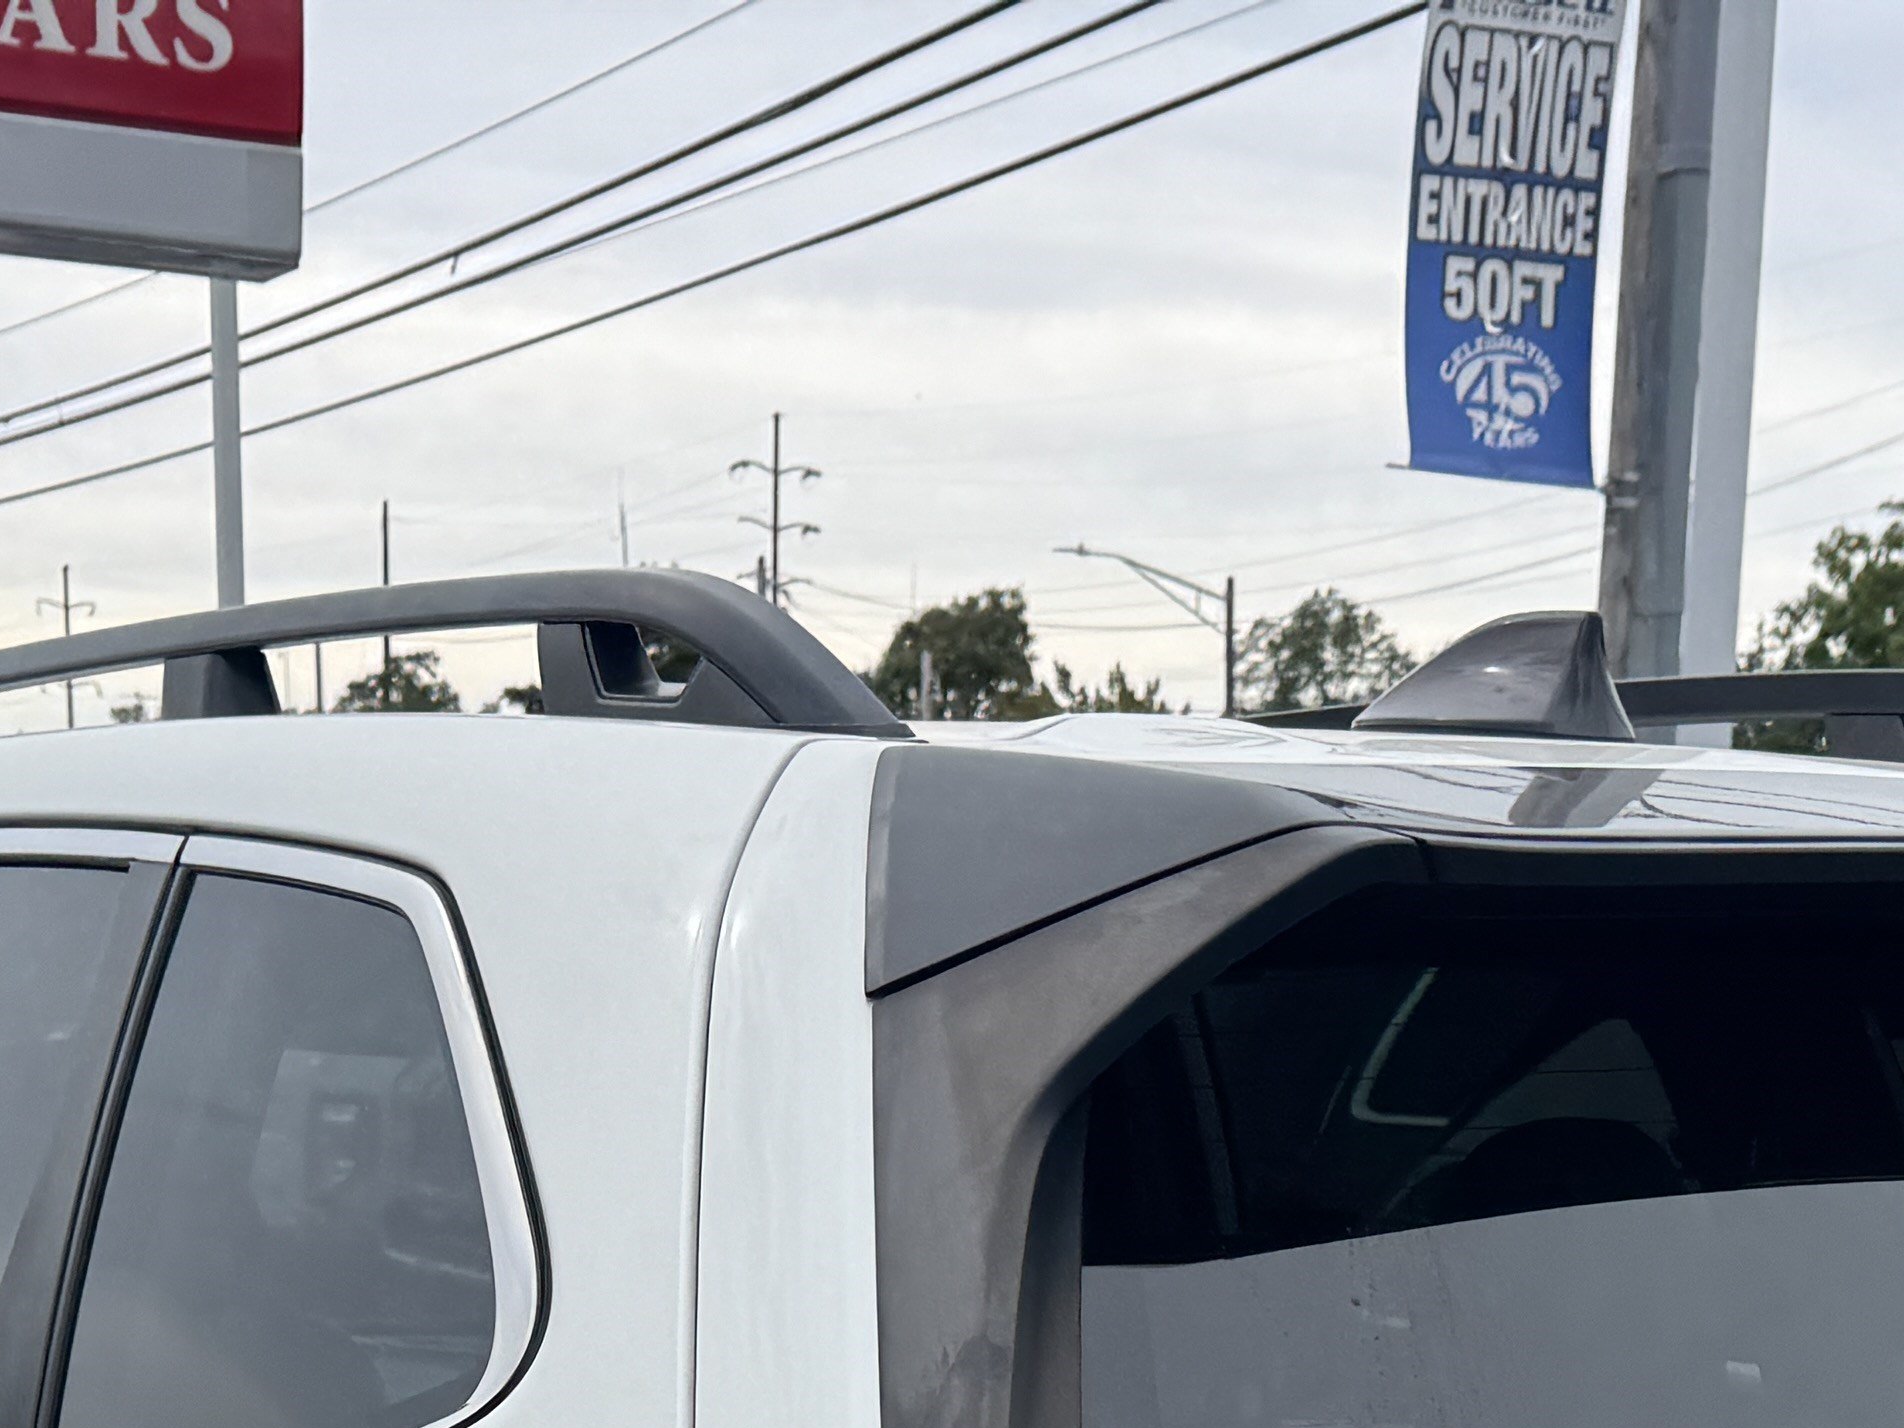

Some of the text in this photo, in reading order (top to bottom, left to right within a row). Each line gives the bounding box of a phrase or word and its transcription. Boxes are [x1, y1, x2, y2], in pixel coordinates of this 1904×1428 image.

[1423, 23, 1615, 180] SERVICE
[1415, 174, 1597, 257] ENTRANCE
[1455, 352, 1550, 417] 45
